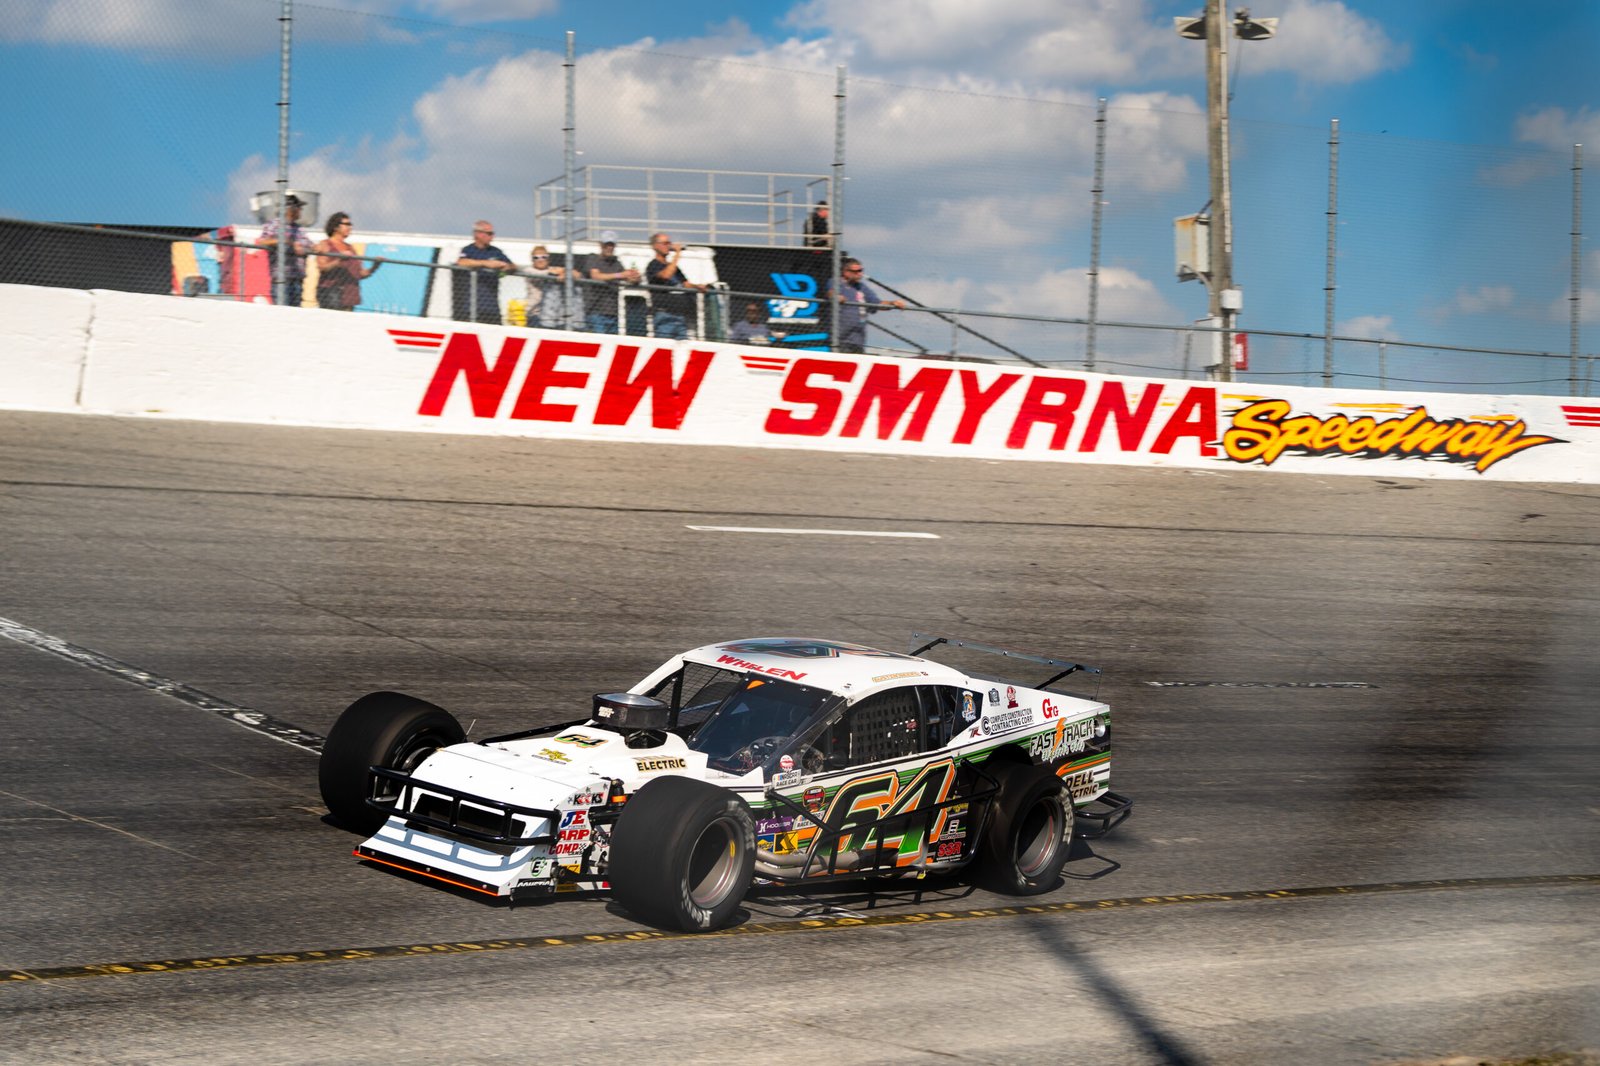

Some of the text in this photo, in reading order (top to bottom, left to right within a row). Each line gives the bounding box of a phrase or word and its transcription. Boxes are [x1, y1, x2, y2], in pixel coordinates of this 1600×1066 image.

[417, 332, 1571, 473] NEW SMYRNA Speedway
[716, 654, 808, 681] WHELEN
[991, 719, 1021, 732] CONTRACTING
[1030, 730, 1057, 755] FAST
[1062, 718, 1095, 742] TRACK
[636, 758, 686, 772] ELECTRIC
[1071, 784, 1098, 799] CTRIC
[573, 792, 604, 806] KOOKS
[560, 810, 587, 828] JE
[558, 829, 590, 841] ARP
[548, 843, 580, 855] COMP
